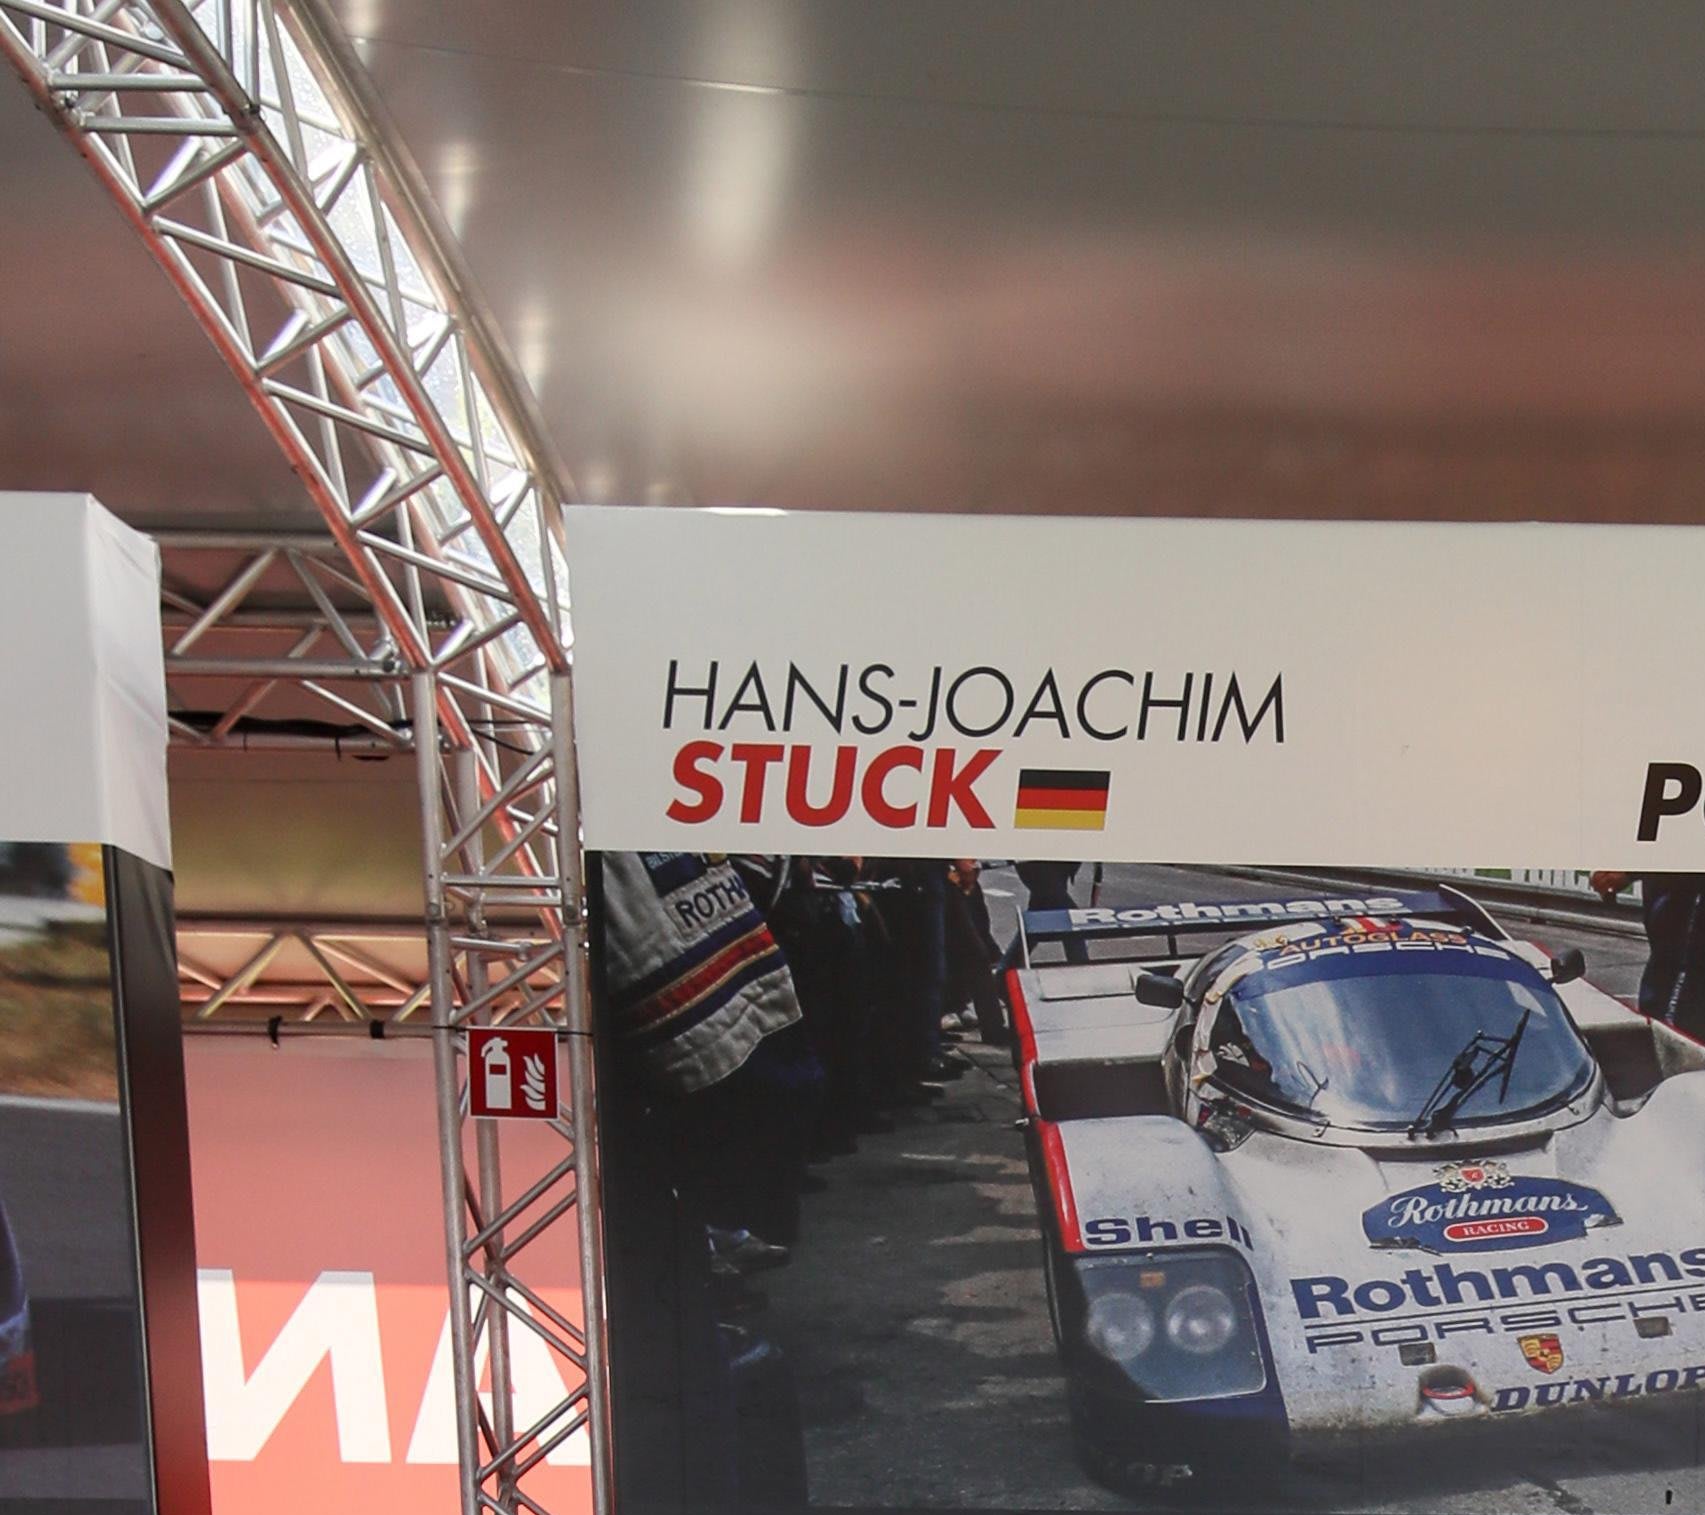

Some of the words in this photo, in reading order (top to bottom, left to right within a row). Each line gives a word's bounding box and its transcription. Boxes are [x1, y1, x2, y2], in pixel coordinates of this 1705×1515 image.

[662, 659, 1285, 744] HANS-JOACHIM
[666, 737, 1003, 829] STUCK
[1067, 897, 1405, 927] Rothmans
[1253, 941, 1510, 971] ORSCHE
[1279, 930, 1467, 956] AUTOGLASS
[1387, 1192, 1589, 1228] Rothmans
[1085, 1215, 1254, 1251] Shell
[1461, 1220, 1531, 1237] RACING
